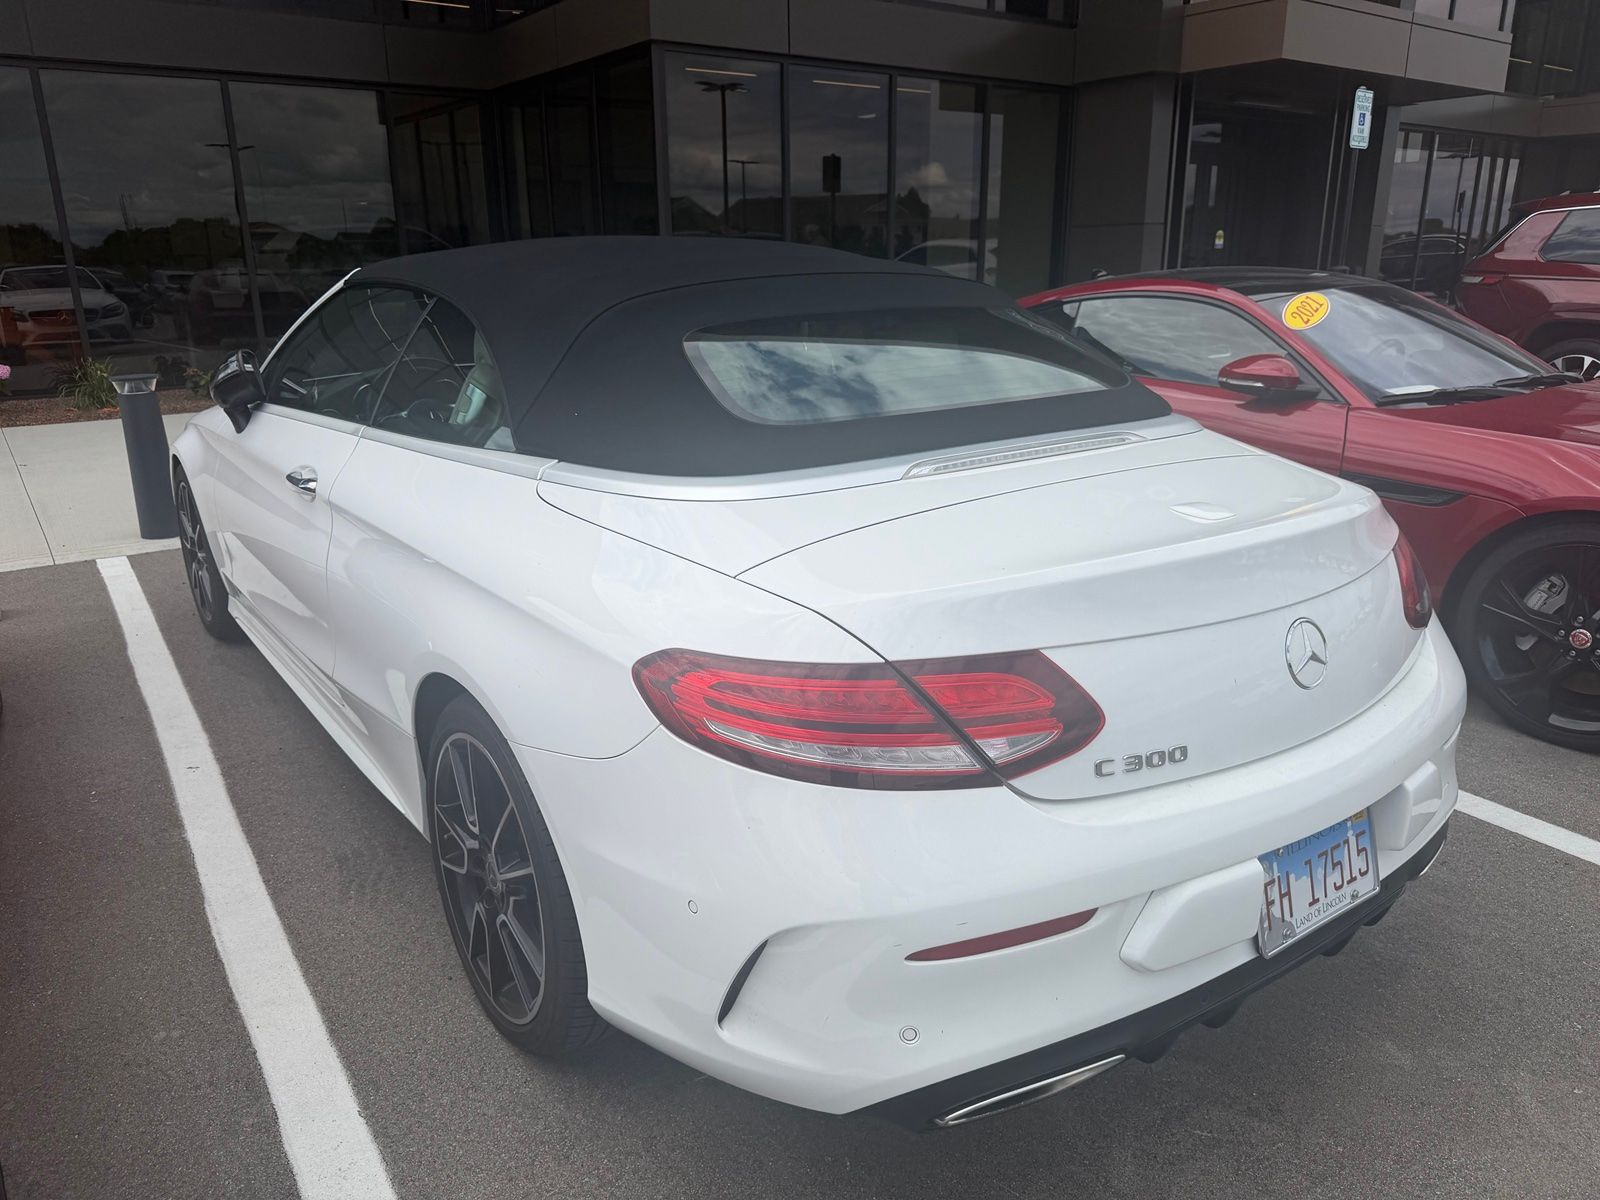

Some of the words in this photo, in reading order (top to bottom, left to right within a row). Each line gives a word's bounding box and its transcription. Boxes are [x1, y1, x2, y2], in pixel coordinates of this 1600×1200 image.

[1290, 295, 1324, 325] 2021
[1094, 758, 1115, 778] C
[1122, 744, 1188, 774] 300
[1264, 870, 1294, 931] FH
[1304, 829, 1370, 908] 17515
[1295, 912, 1313, 929] LAND
[1313, 906, 1322, 918] OF
[1322, 891, 1347, 913] LINCOLN
